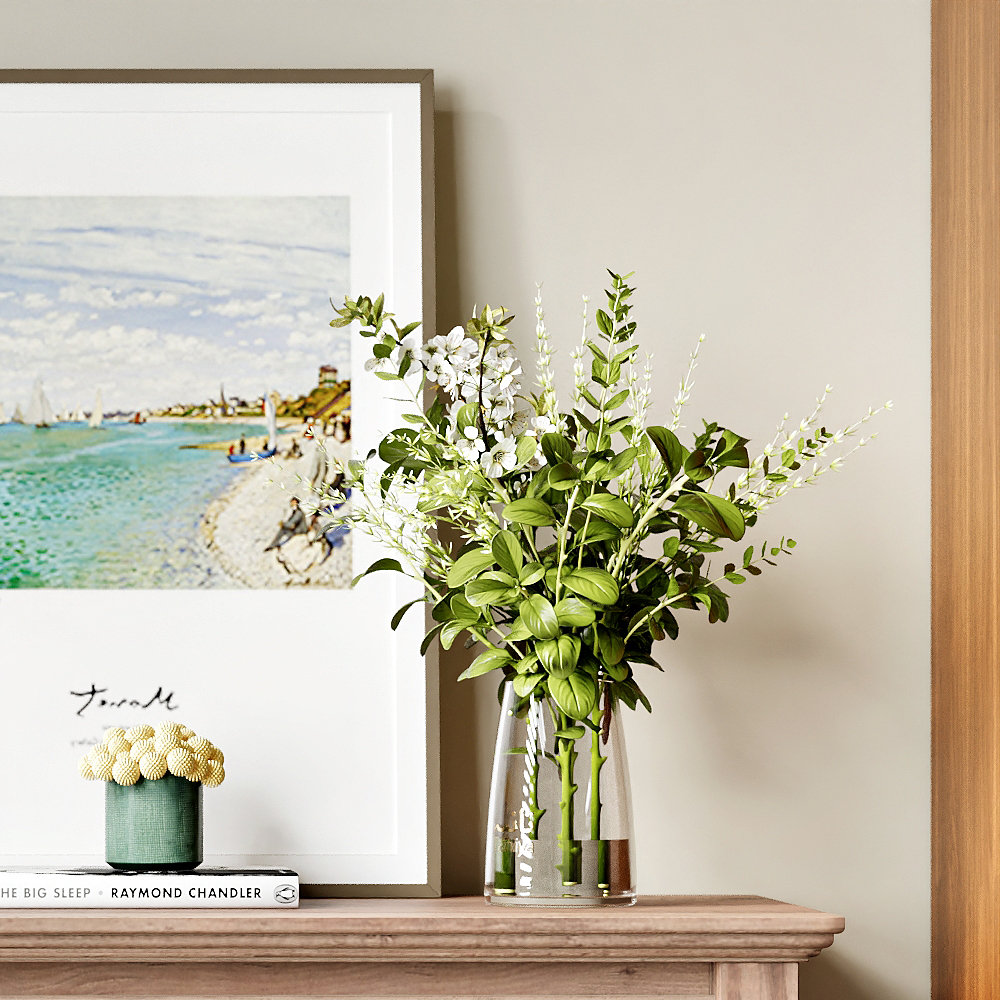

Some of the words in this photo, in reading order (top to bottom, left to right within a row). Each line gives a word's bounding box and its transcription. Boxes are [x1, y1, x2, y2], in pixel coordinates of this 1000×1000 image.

[23, 887, 47, 899] BIG
[53, 887, 91, 899] SLEEP
[111, 887, 183, 899] RAYMOND
[188, 887, 262, 899] CHANDLER
